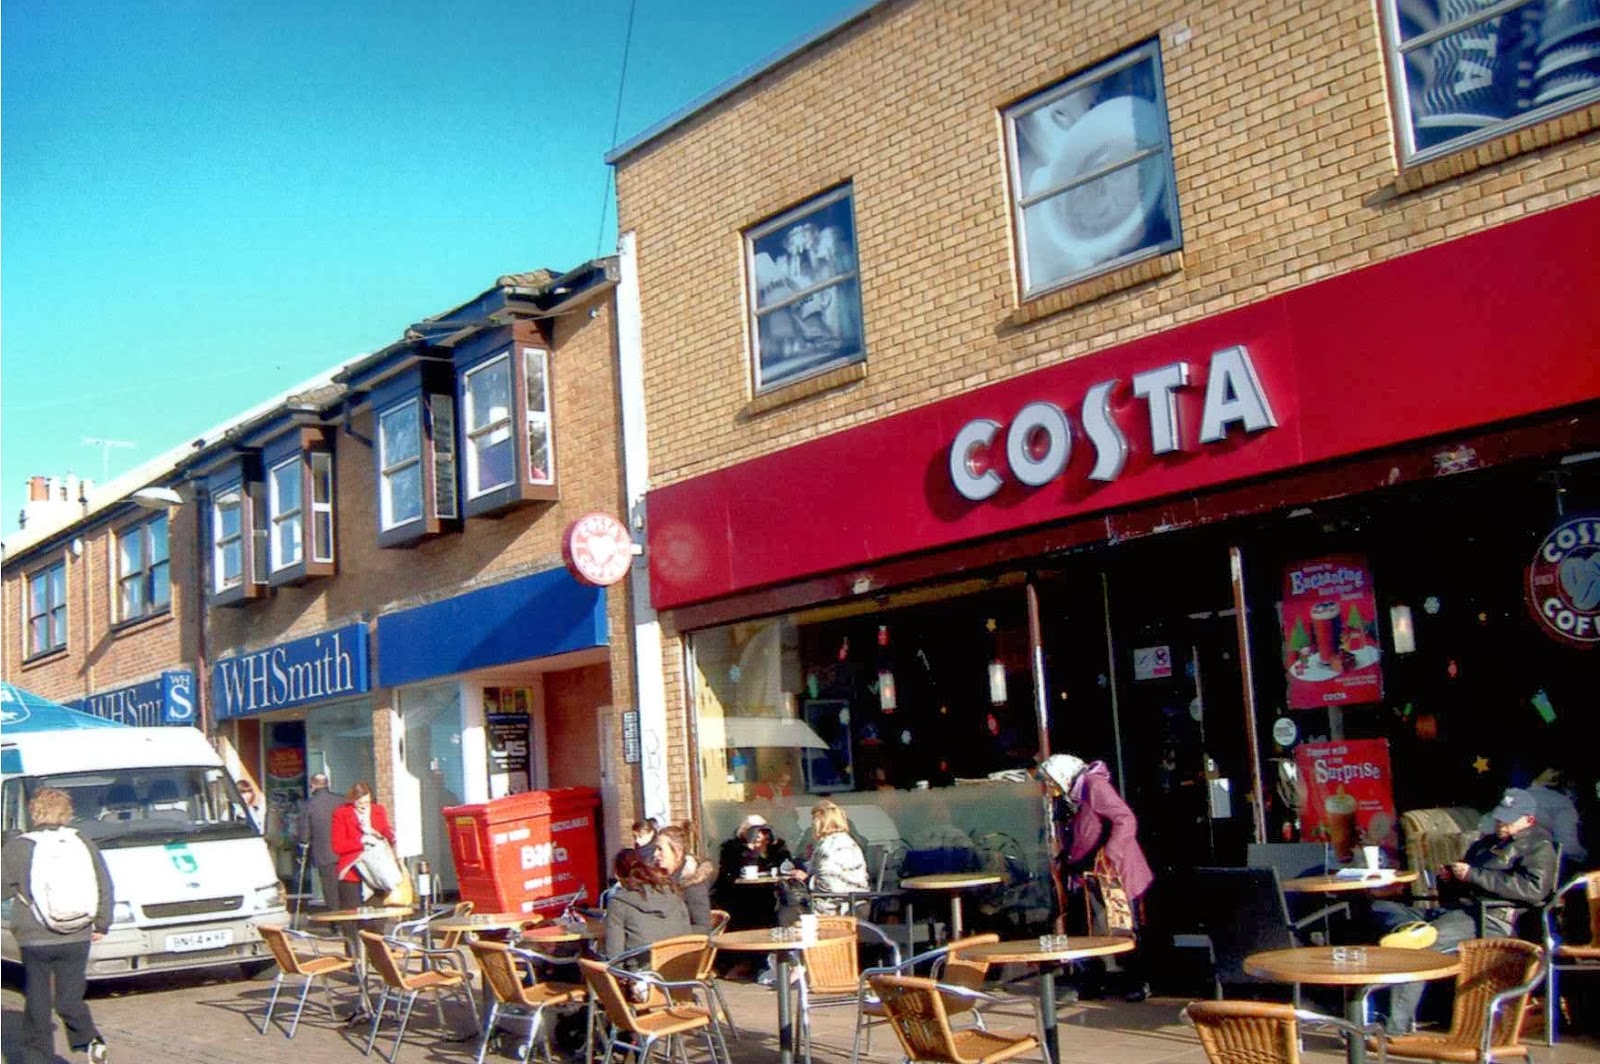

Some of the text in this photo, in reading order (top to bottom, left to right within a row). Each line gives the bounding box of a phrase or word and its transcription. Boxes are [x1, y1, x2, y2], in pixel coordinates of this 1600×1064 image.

[950, 345, 1278, 501] COSTA
[169, 675, 191, 687] WH
[220, 633, 354, 716] WHSmith
[170, 684, 192, 718] S
[1314, 759, 1381, 783] Surprise
